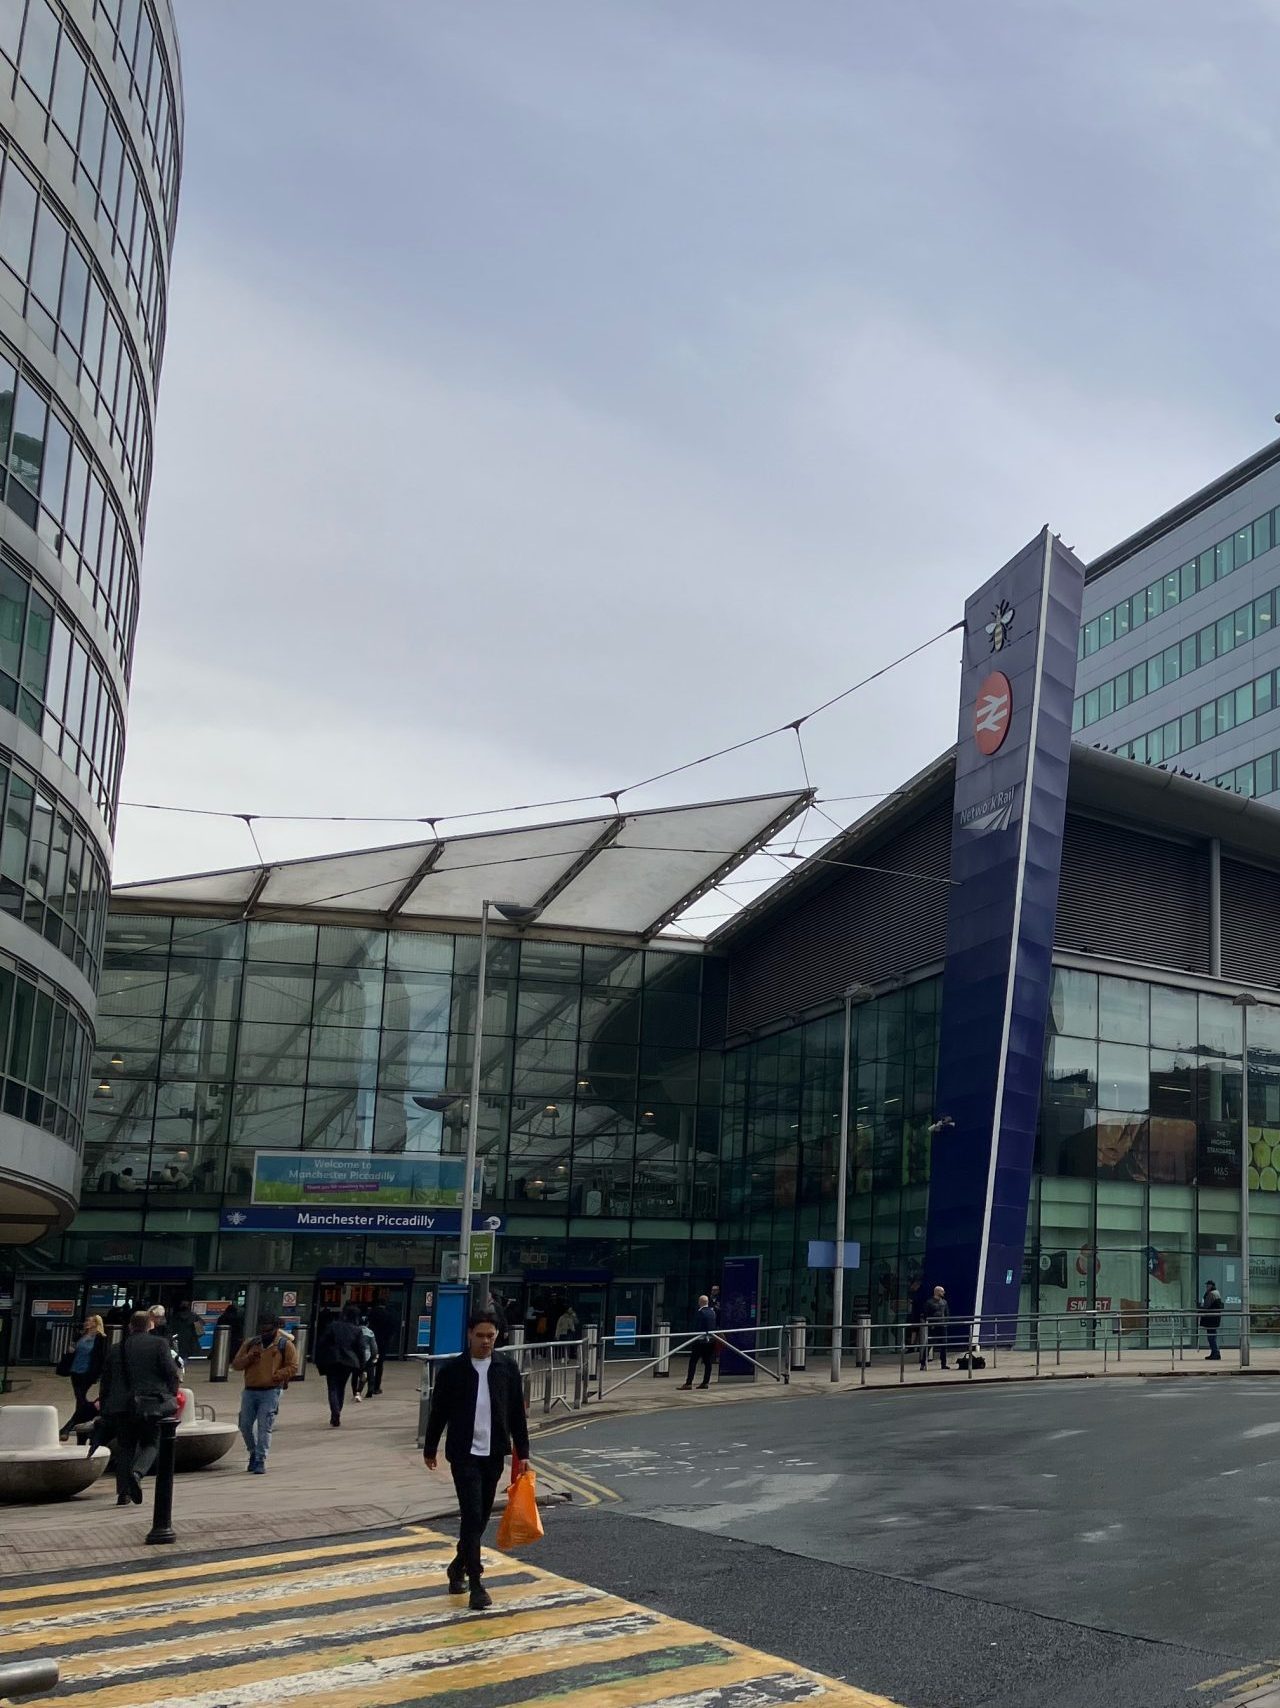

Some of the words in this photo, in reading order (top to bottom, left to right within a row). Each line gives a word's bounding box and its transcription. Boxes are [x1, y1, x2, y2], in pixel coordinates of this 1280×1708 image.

[960, 795, 996, 825] Network
[997, 785, 1015, 807] Rail
[314, 1159, 359, 1169] Welcome
[361, 1160, 372, 1169] to
[288, 1170, 347, 1180] Manchester
[350, 1169, 396, 1182] Piccadilly
[297, 1213, 373, 1226] Manchester
[377, 1214, 435, 1229] Piccadilly
[1069, 1300, 1109, 1311] SMRT
